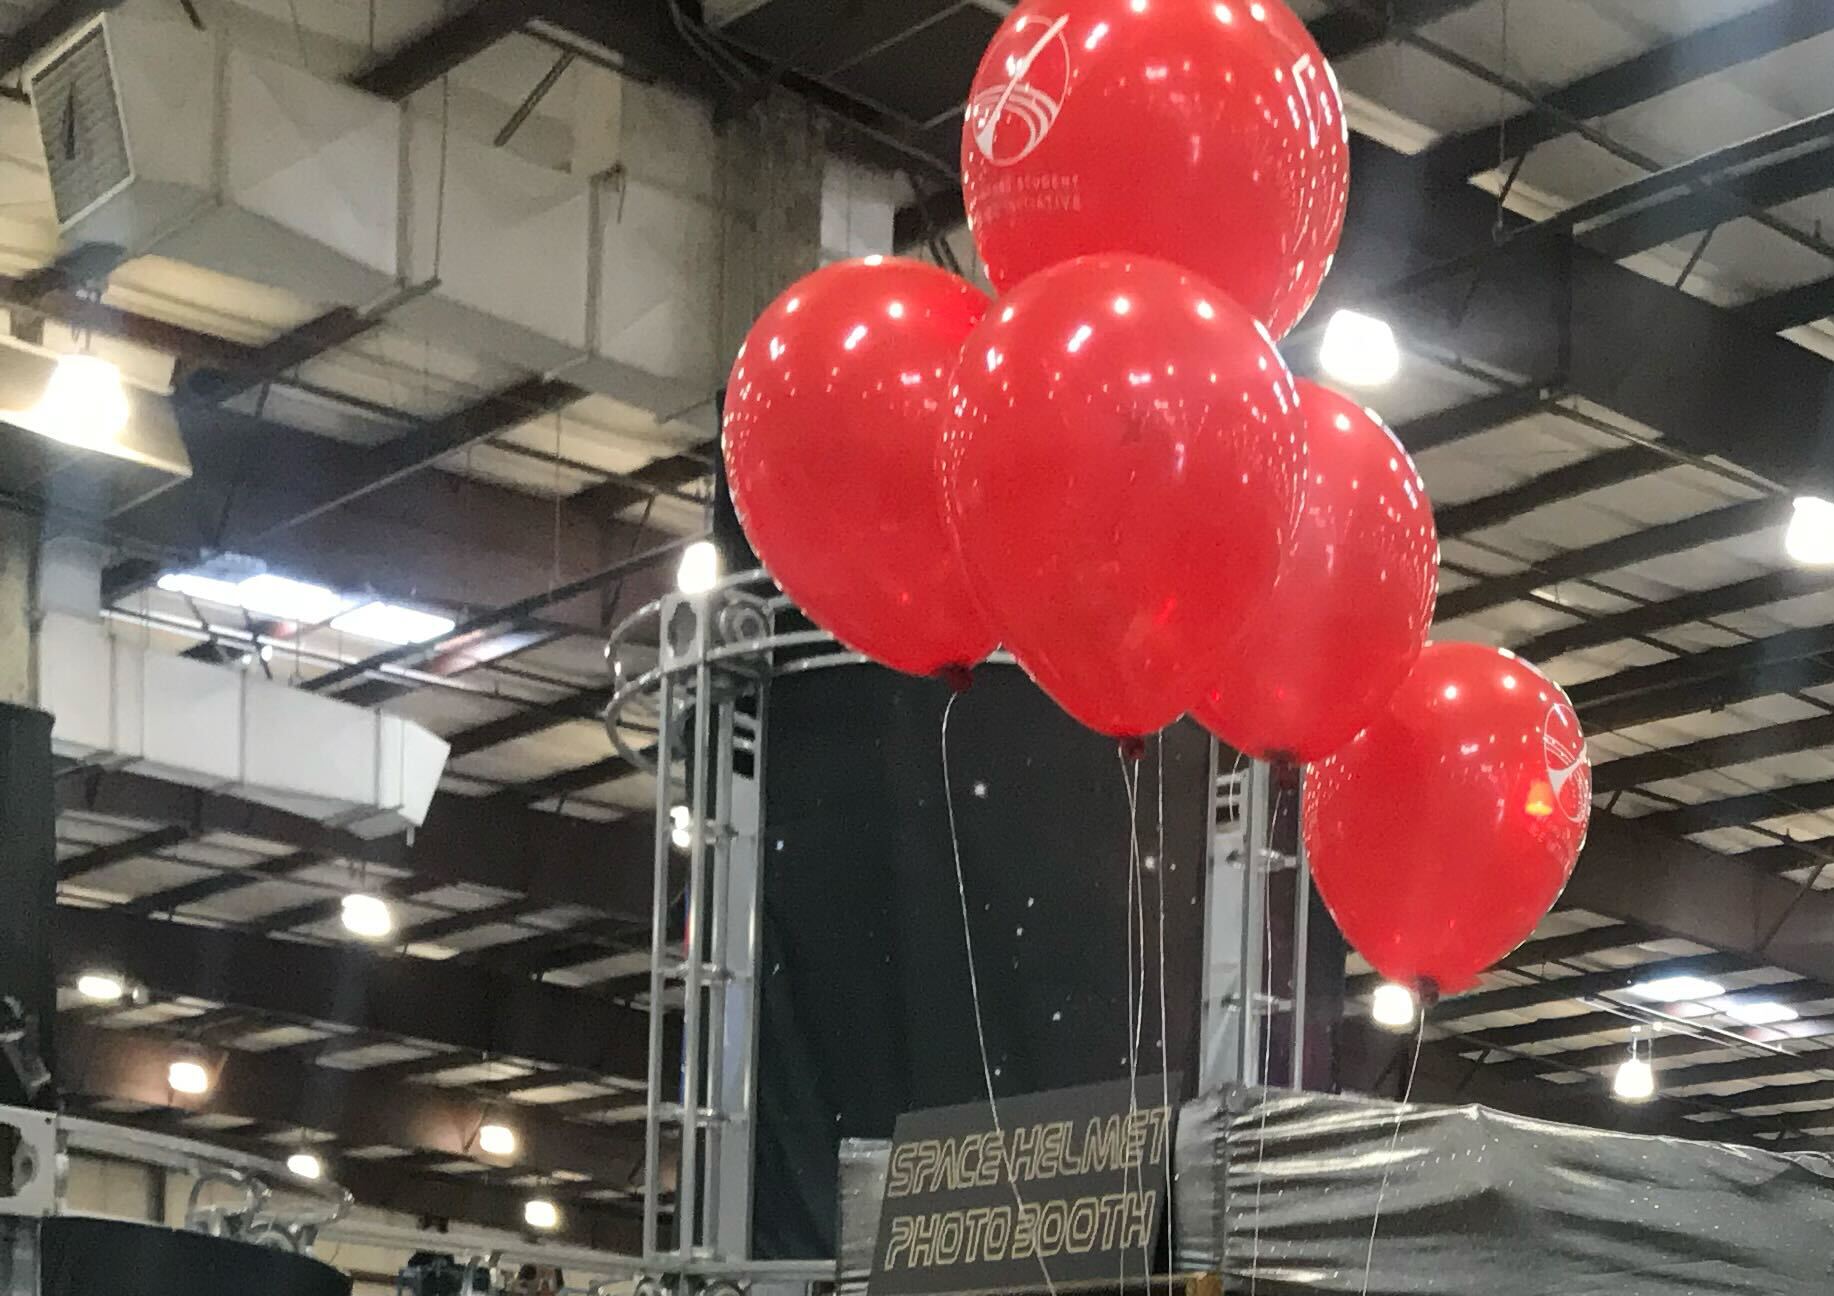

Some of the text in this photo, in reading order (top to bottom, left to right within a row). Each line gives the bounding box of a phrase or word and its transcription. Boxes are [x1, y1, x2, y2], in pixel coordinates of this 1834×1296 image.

[888, 1107, 1171, 1199] SPACE HELMET
[885, 1190, 1156, 1271] PHOTO BOOTH
